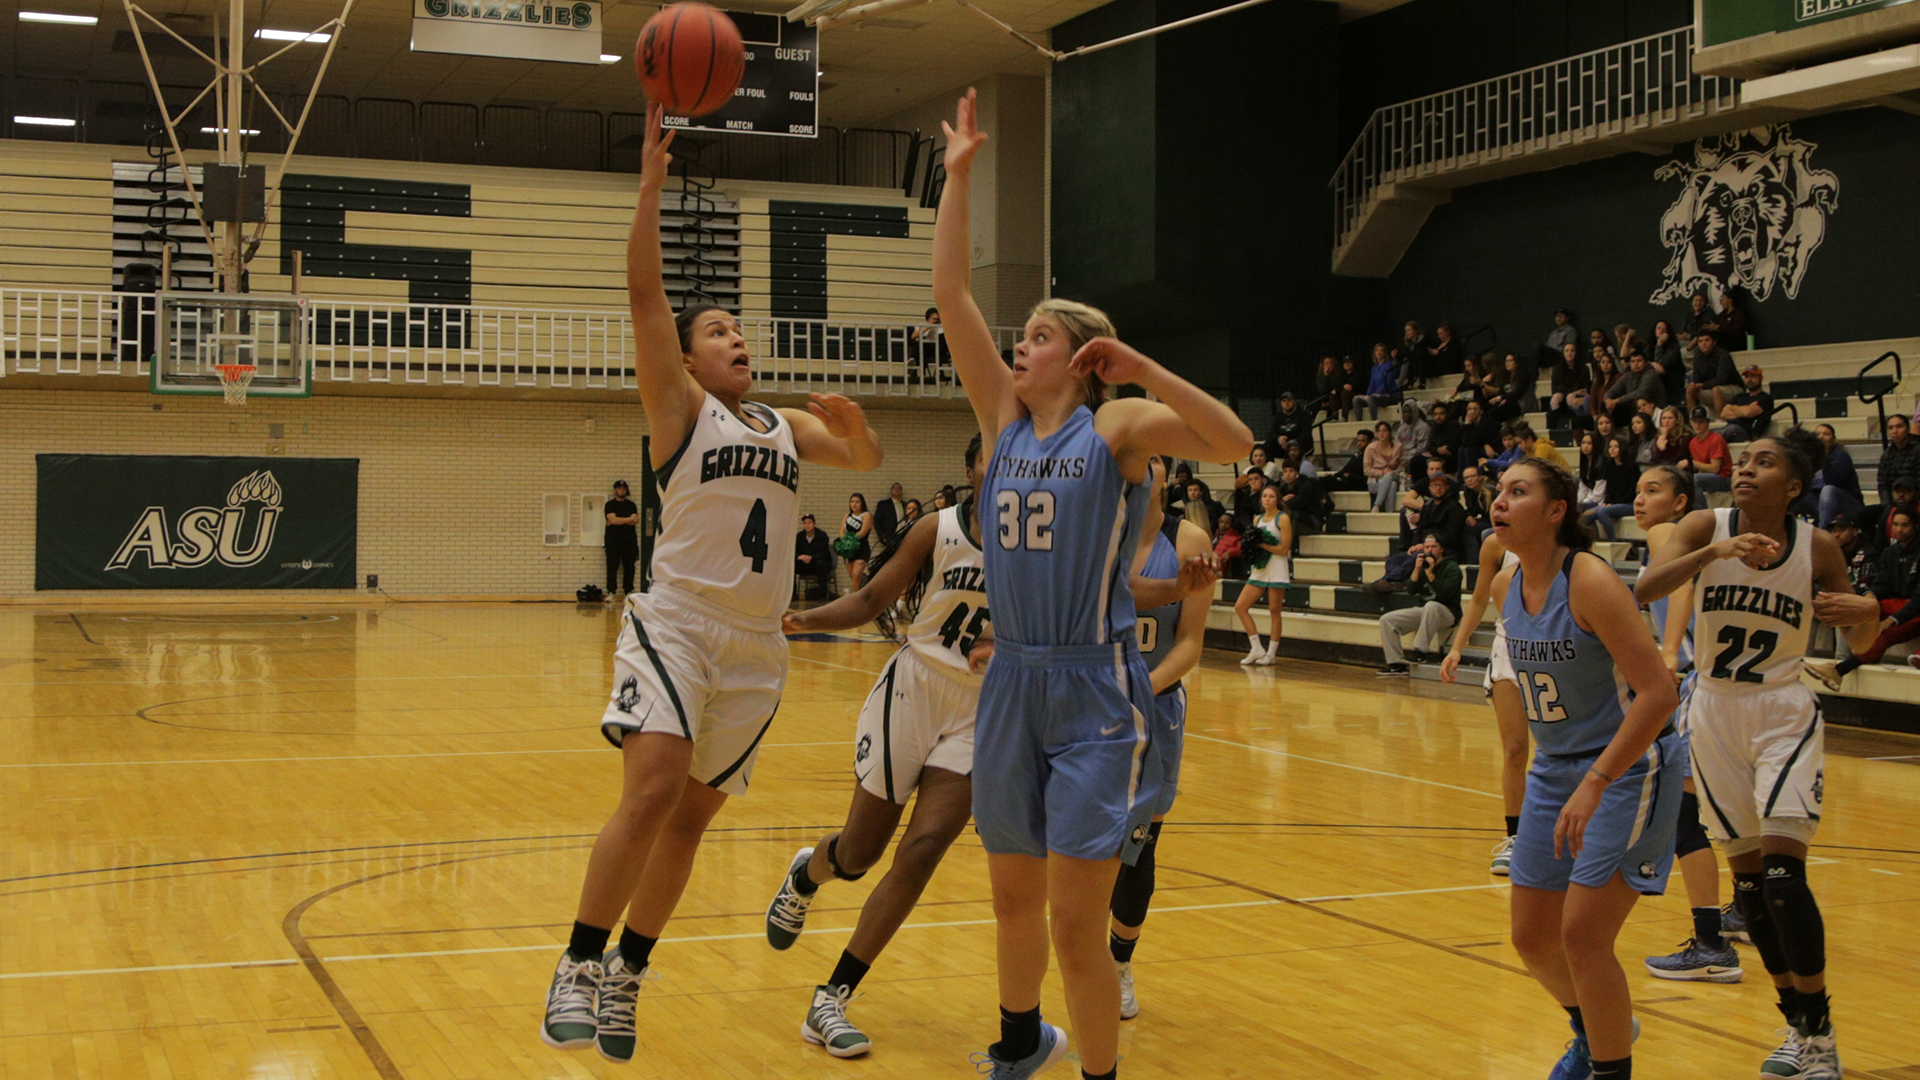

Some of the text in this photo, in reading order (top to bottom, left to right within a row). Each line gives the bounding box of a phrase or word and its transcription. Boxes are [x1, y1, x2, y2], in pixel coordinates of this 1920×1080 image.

[424, 0, 592, 28] GRIZZLIES
[774, 47, 811, 62] GUEST
[746, 88, 766, 98] FOUL
[789, 91, 814, 102] FOULS
[664, 116, 690, 126] SCORE
[726, 120, 753, 130] MATCH
[789, 124, 814, 134] SCORE
[104, 506, 280, 572] ASU
[739, 498, 769, 574] 4
[997, 489, 1056, 552] 32
[1702, 584, 1804, 631] GRIZZLIES
[938, 602, 992, 658] 45
[1710, 625, 1779, 684] 22
[1518, 670, 1569, 723] 12
